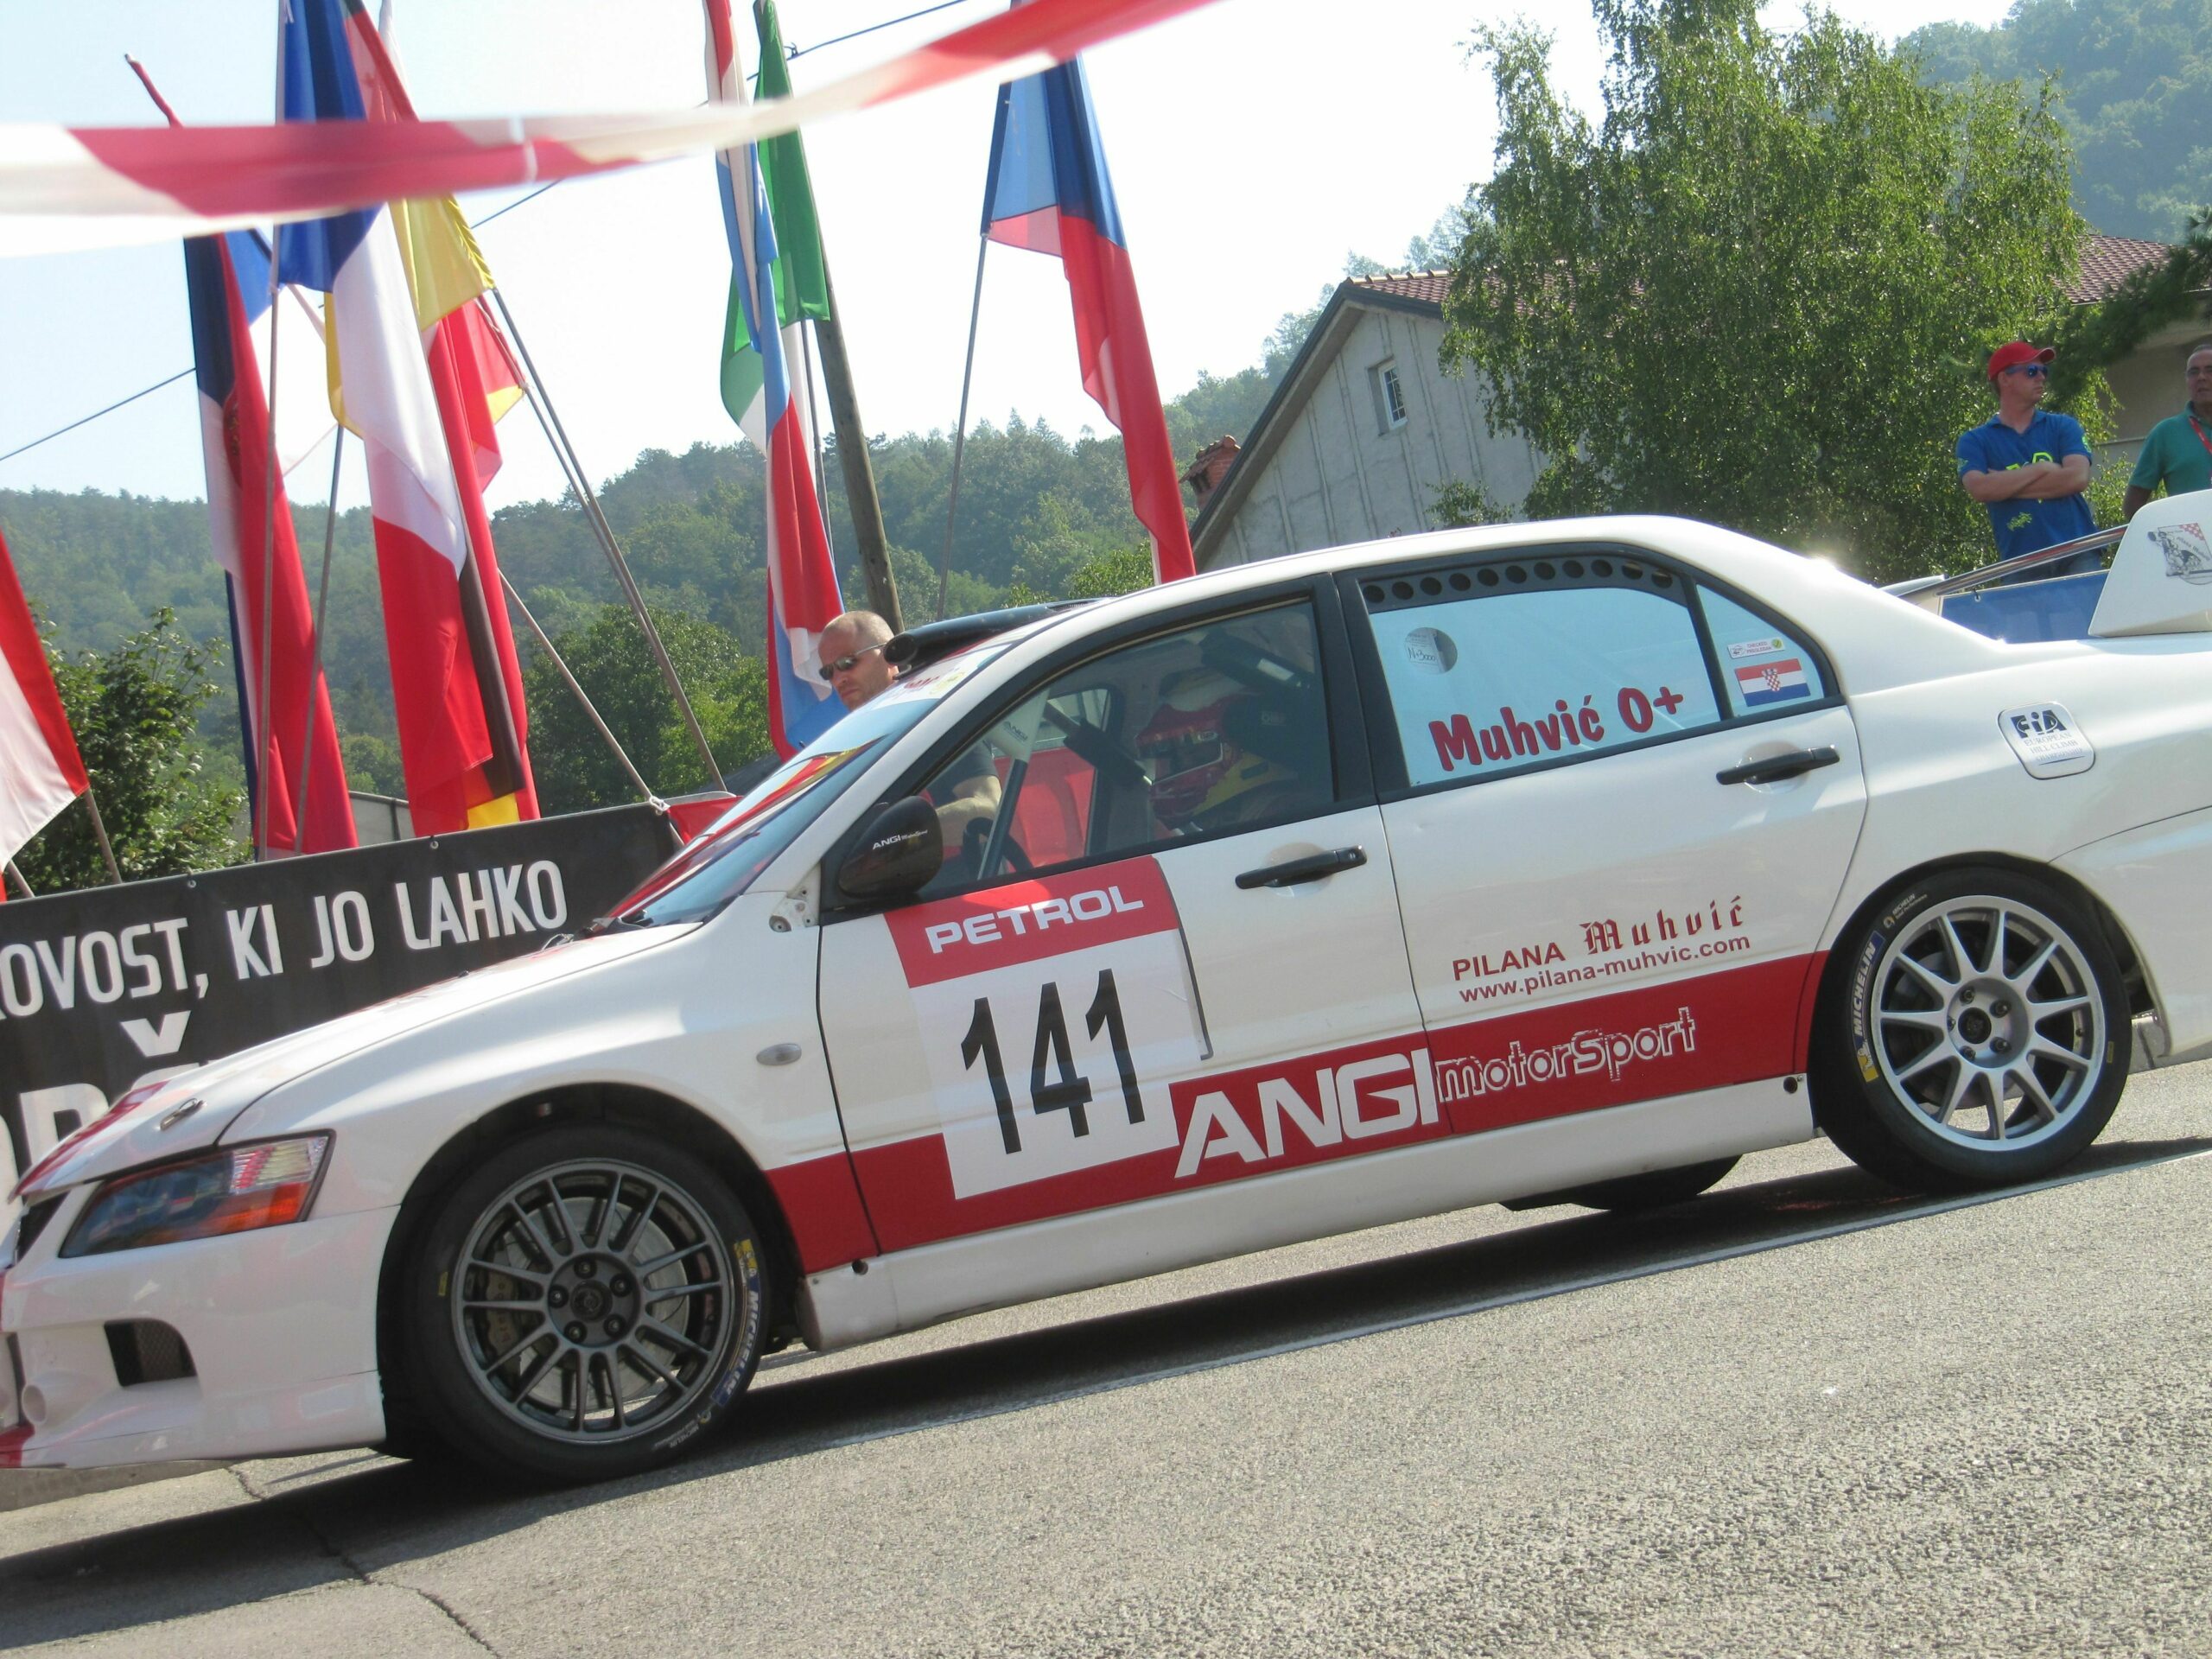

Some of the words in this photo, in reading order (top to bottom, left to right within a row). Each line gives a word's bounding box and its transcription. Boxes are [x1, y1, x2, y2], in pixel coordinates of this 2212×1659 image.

[1428, 694, 1605, 772] Muhvić
[872, 834, 900, 850] ANGI
[0, 918, 208, 1020] OVOST,
[226, 904, 283, 981] KI
[310, 891, 375, 969] JO
[395, 860, 569, 950] LAHKO
[925, 886, 1144, 954] PETROL
[1452, 942, 1566, 981] PILANA
[1580, 895, 1744, 955] Muhvić
[1459, 935, 1751, 1002] www.pilana-muhvic.com
[1853, 940, 1876, 1037] MICHELIN
[961, 968, 1145, 1154] 141
[1173, 1047, 1439, 1179] ANGI
[727, 1292, 760, 1395] MICHELIN
